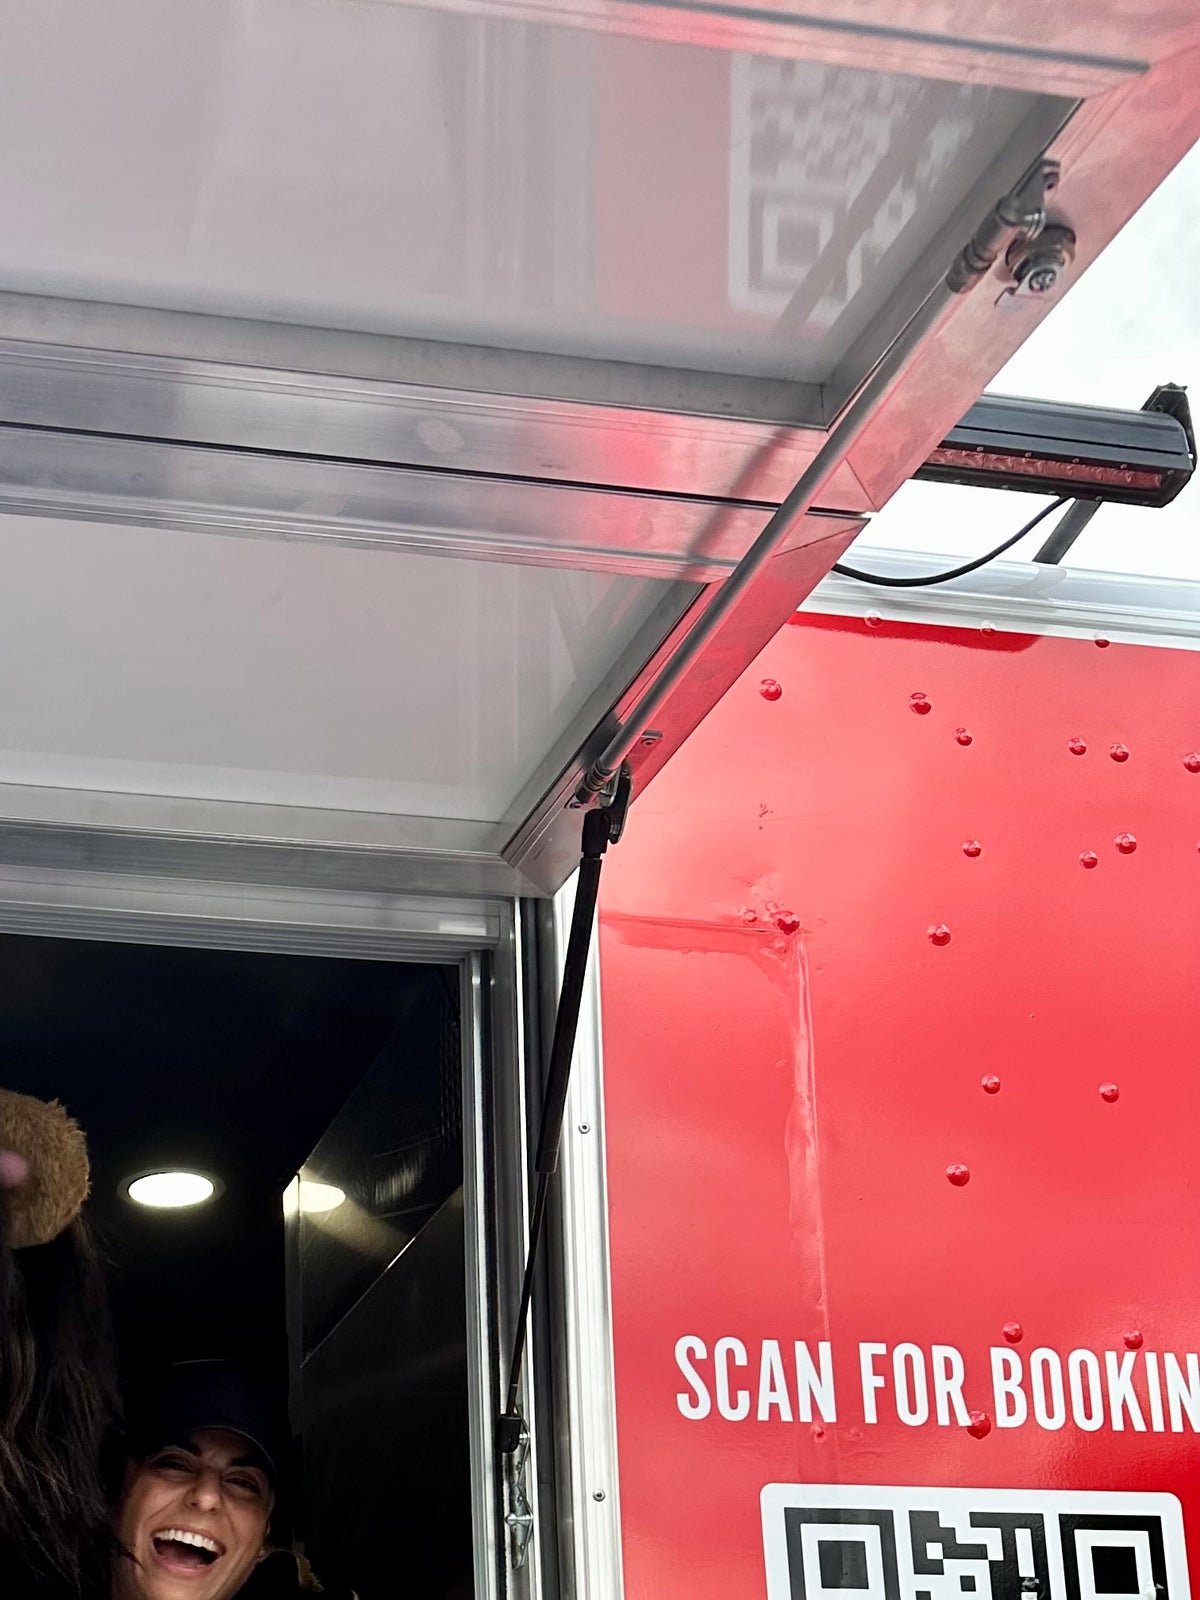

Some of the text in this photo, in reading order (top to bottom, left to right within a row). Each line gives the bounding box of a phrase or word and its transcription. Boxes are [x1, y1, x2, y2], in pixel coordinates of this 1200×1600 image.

[674, 1334, 1200, 1433] SCAN FOR BOOKIN
